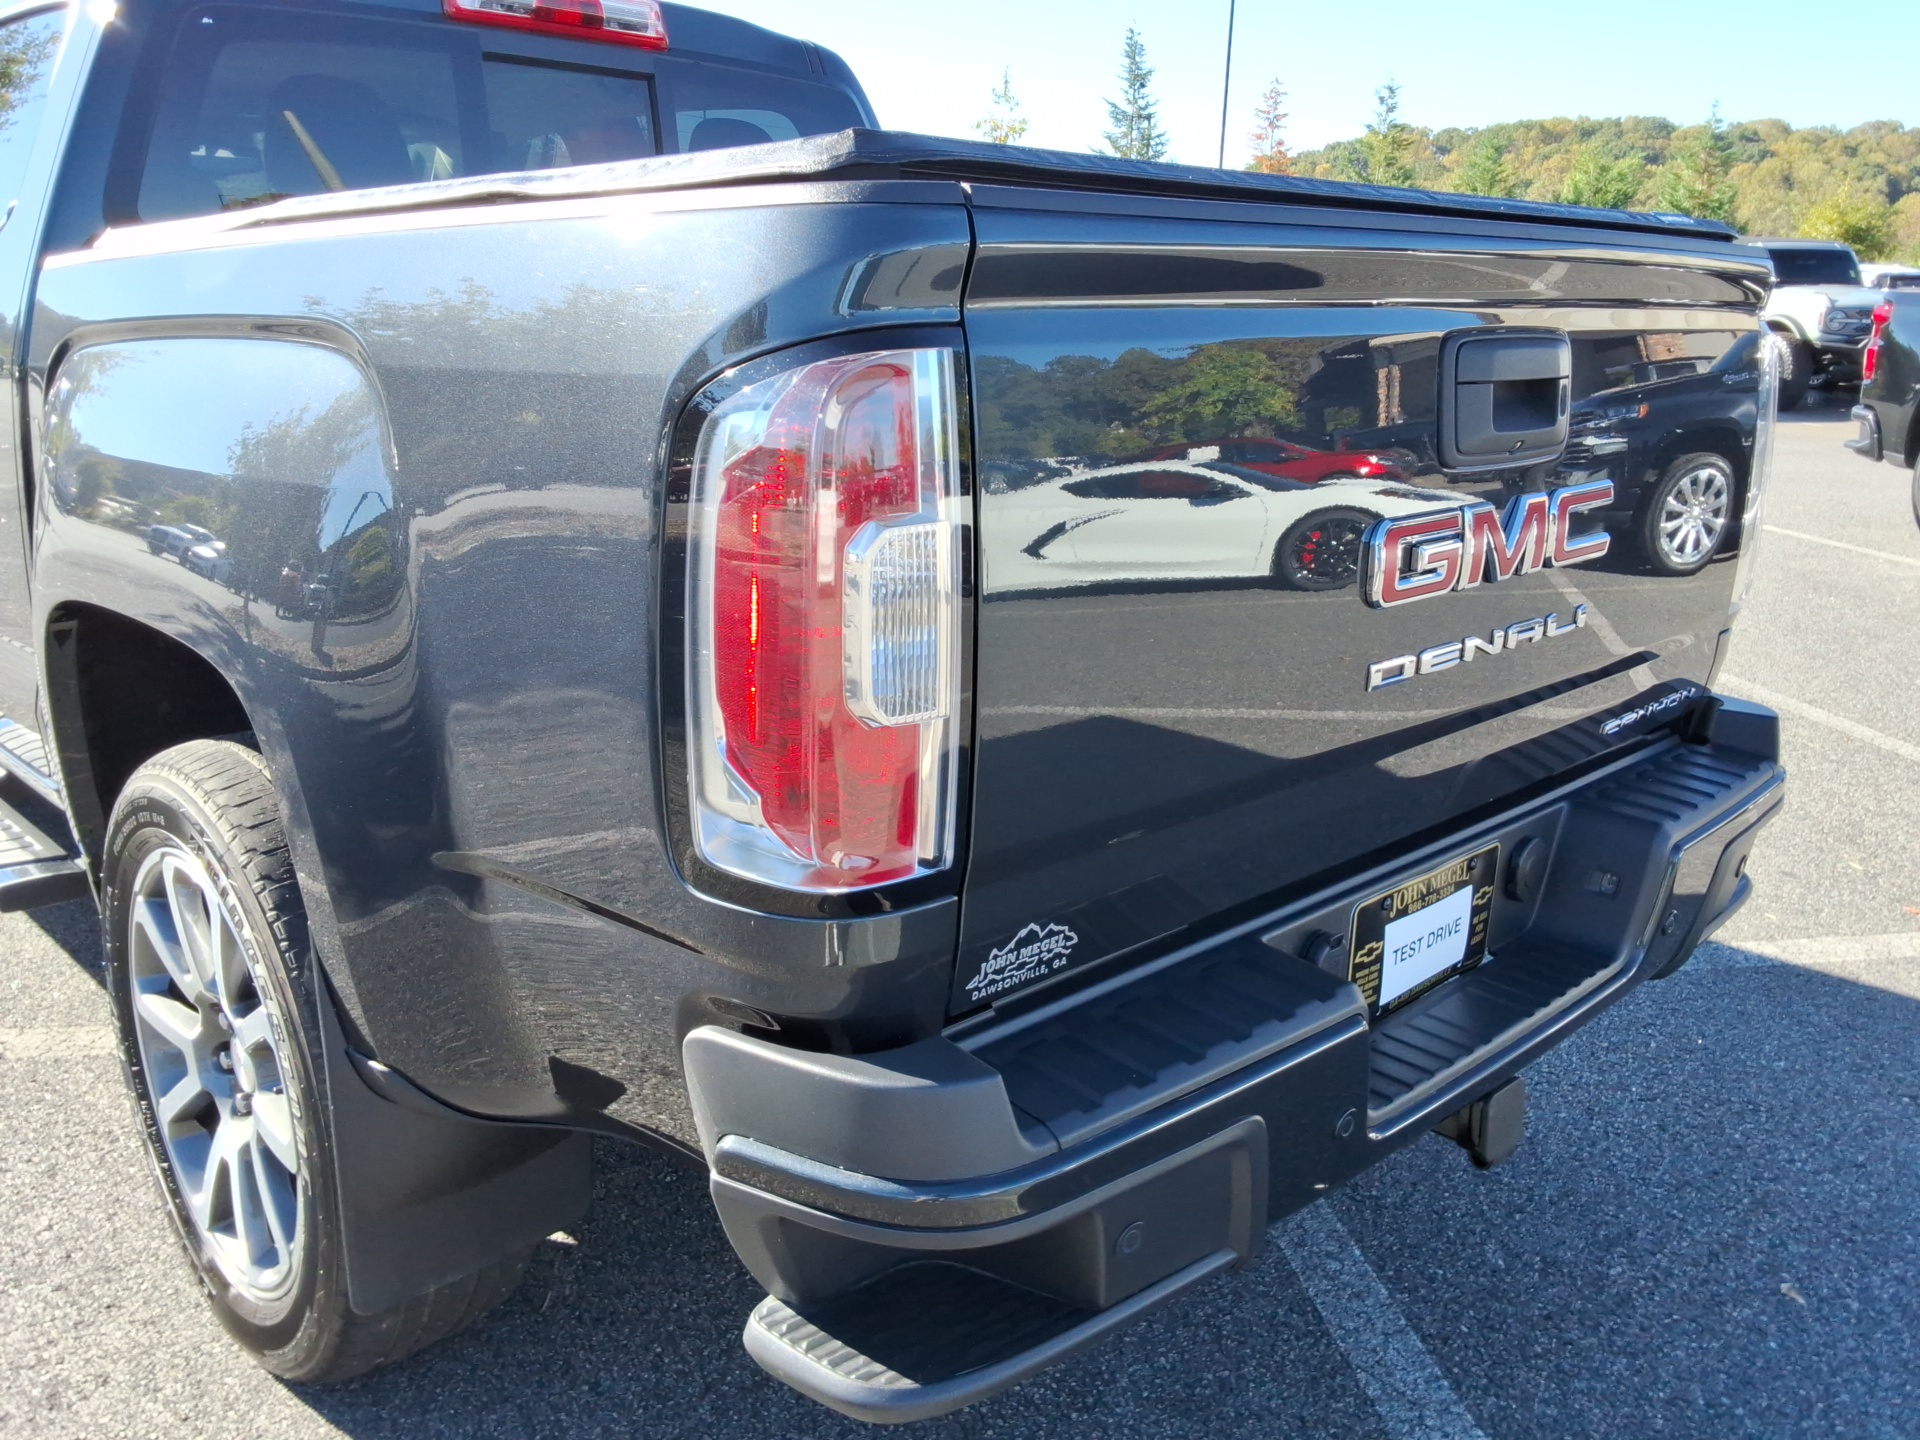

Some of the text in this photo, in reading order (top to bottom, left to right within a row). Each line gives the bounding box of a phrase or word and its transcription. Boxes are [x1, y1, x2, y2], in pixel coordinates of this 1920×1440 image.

[1359, 479, 1615, 610] GMC
[1365, 603, 1589, 693] DENALI
[1390, 860, 1470, 918] JOHN MEGEL
[979, 933, 1066, 981] JOHN MEGEL
[1392, 936, 1424, 966] TEST
[1427, 916, 1462, 949] DRIVE
[971, 956, 1067, 1001] DAWSONVILLE, GA
